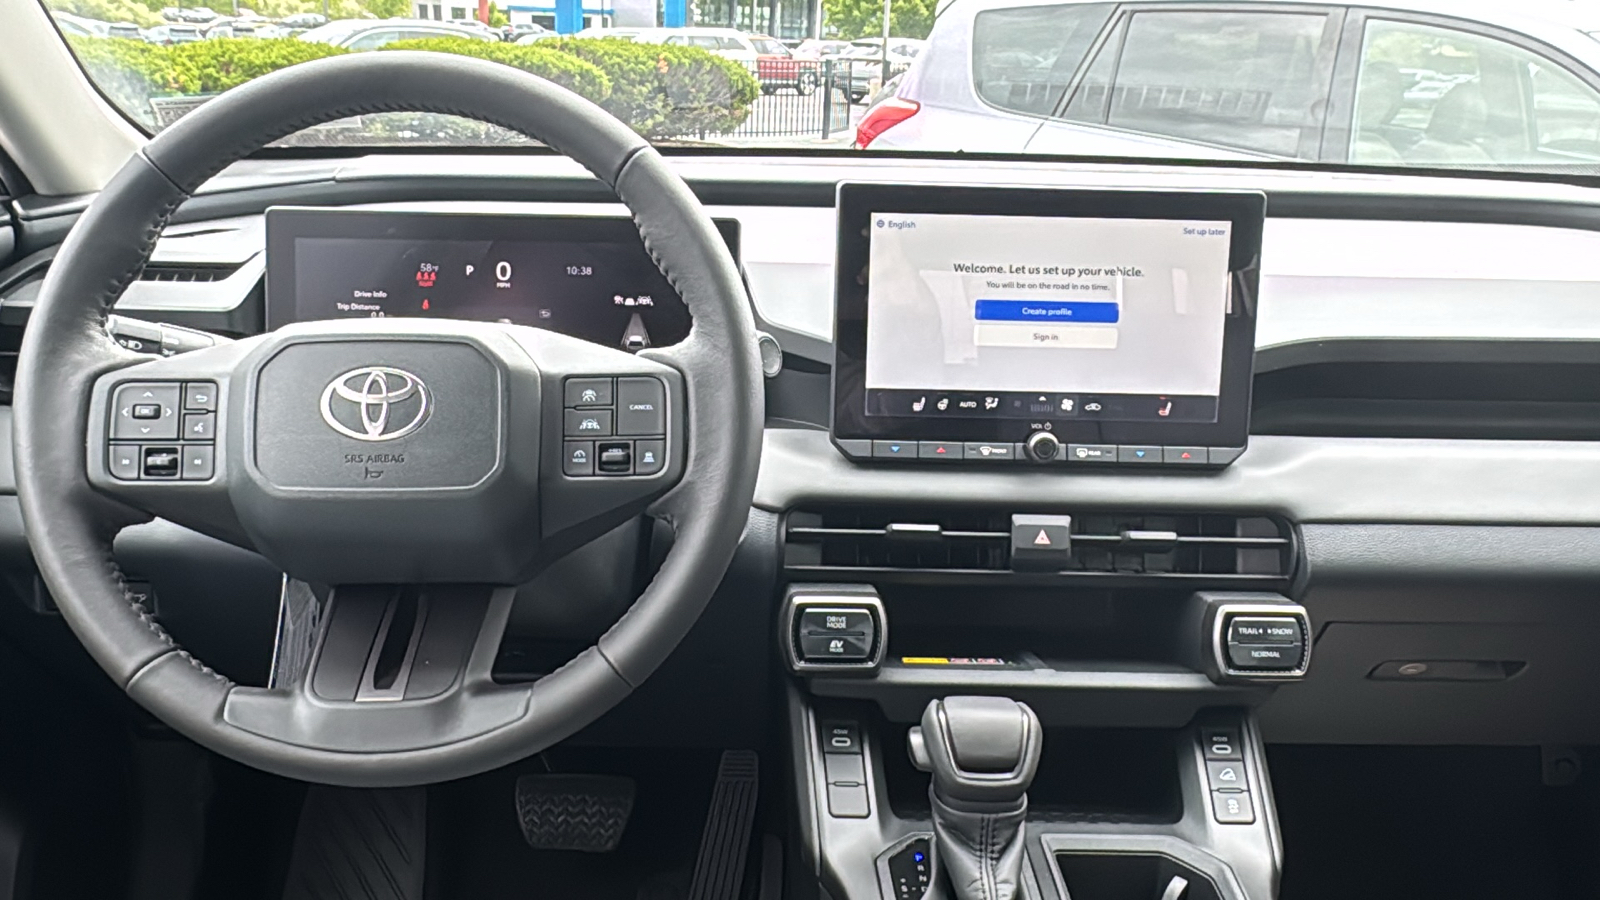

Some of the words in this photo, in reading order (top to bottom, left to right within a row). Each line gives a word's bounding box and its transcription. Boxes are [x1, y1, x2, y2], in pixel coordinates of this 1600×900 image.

[888, 221, 916, 229] English
[465, 265, 475, 276] P
[496, 261, 512, 281] 0
[566, 266, 593, 276] 10:38
[953, 263, 1007, 273] Welcome.
[1009, 265, 1026, 274] Let
[1028, 266, 1041, 275] us
[1043, 266, 1059, 275] set
[1061, 267, 1076, 277] up
[1077, 268, 1103, 278] your
[1104, 266, 1145, 277] vehicle.
[1002, 281, 1015, 289] will
[1039, 282, 1051, 290] the
[354, 290, 372, 298] Drive
[373, 290, 387, 298] Info
[336, 303, 350, 311] Trip
[1021, 307, 1047, 315] Create
[1048, 308, 1073, 316] profile
[1033, 332, 1050, 342] Sign
[344, 454, 364, 463] SRS
[366, 454, 405, 463] AIRBAG
[826, 621, 847, 629] MODE
[829, 640, 844, 648] EV
[1251, 650, 1280, 658] NORMAL
